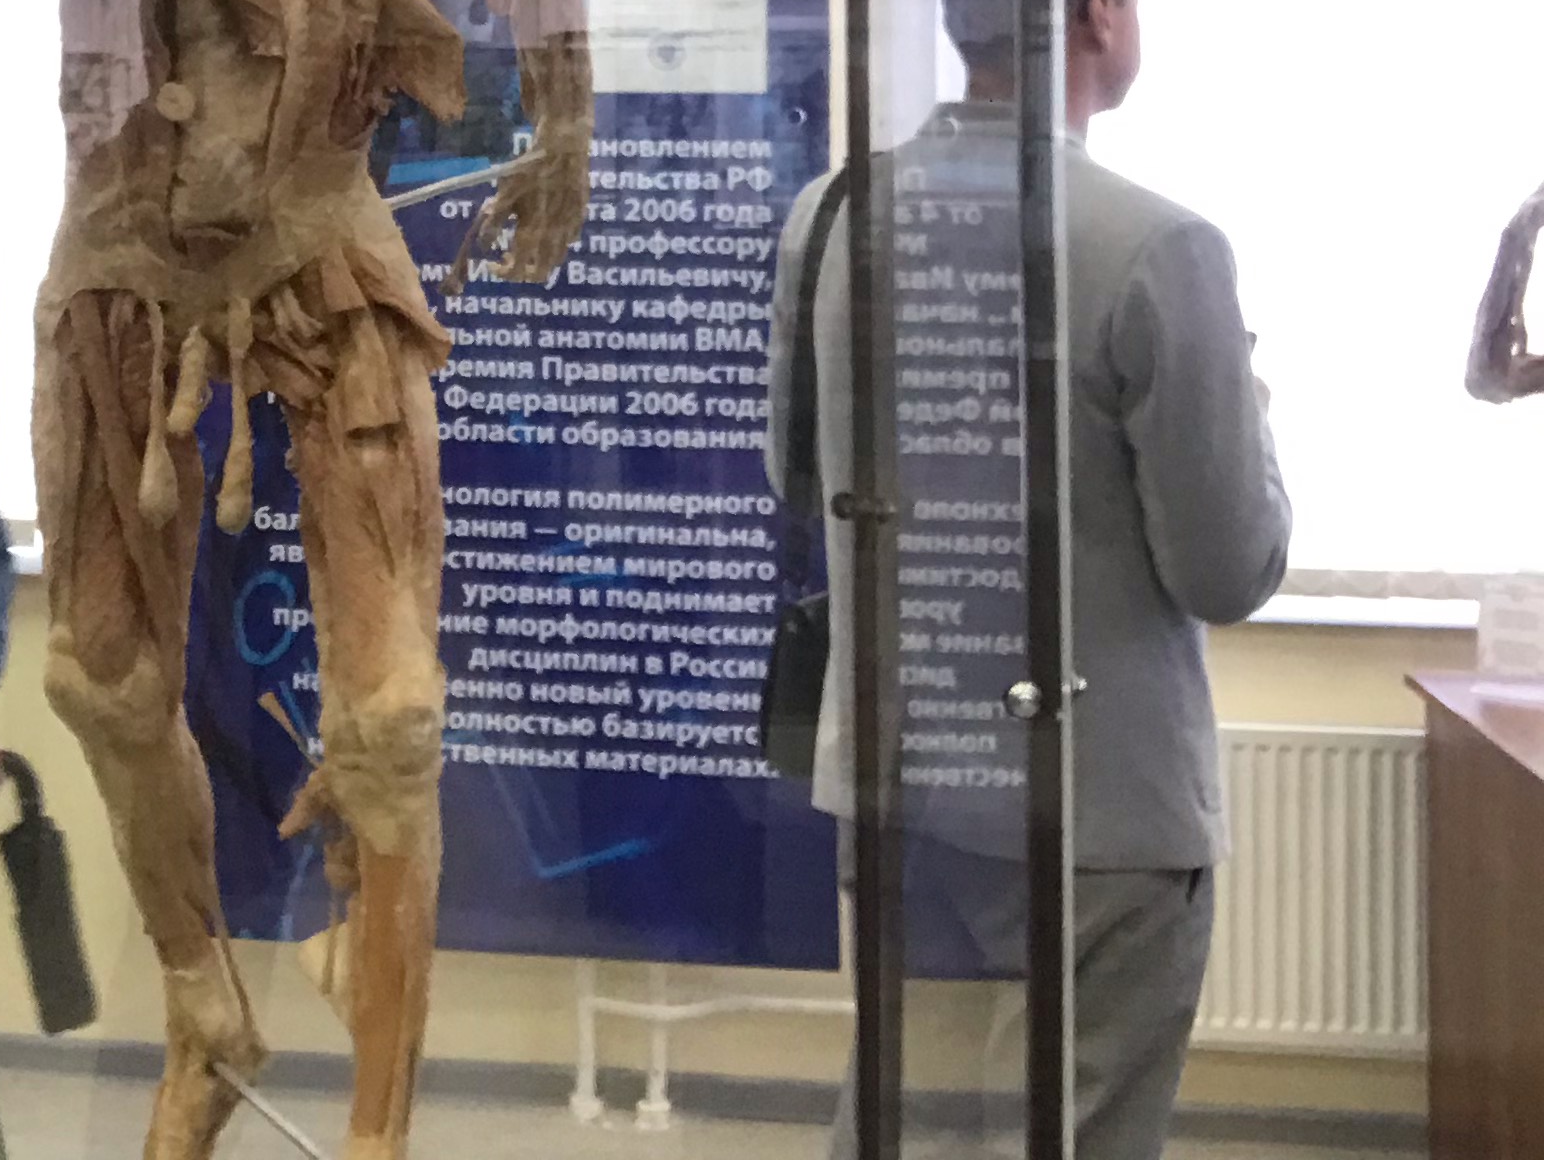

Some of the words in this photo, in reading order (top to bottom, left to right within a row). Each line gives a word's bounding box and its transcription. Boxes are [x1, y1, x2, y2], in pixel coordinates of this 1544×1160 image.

[588, 171, 721, 191] тельства
[726, 166, 773, 191] РФ
[439, 201, 473, 220] от
[624, 198, 696, 223] 2006
[702, 204, 773, 229] года
[589, 229, 774, 261] профессору
[568, 261, 774, 294] Васильевичу,
[444, 295, 626, 324] начальнику
[631, 294, 773, 325] кафедры
[538, 330, 690, 353] анатомии
[438, 359, 535, 382] ремия
[542, 356, 773, 387] Правительства
[444, 385, 619, 418] Федерации
[625, 391, 700, 416] 2006
[705, 397, 773, 422] года
[437, 416, 557, 444] области
[561, 419, 768, 452] образования
[443, 487, 560, 509] нология
[567, 490, 776, 520] полимерного
[564, 522, 776, 551] оригинальна,
[446, 551, 616, 575] стижением
[622, 557, 776, 585] мирового
[461, 583, 573, 608] уровня
[579, 588, 600, 607] и
[605, 588, 776, 614] поднимает
[496, 613, 776, 646] морфологических
[467, 647, 638, 674] дисциплин
[644, 656, 663, 675] в
[529, 681, 633, 705] новый
[447, 711, 596, 736] олностью
[601, 711, 761, 748] базируетс
[448, 743, 580, 770] твенных
[583, 746, 781, 780] материалах.
